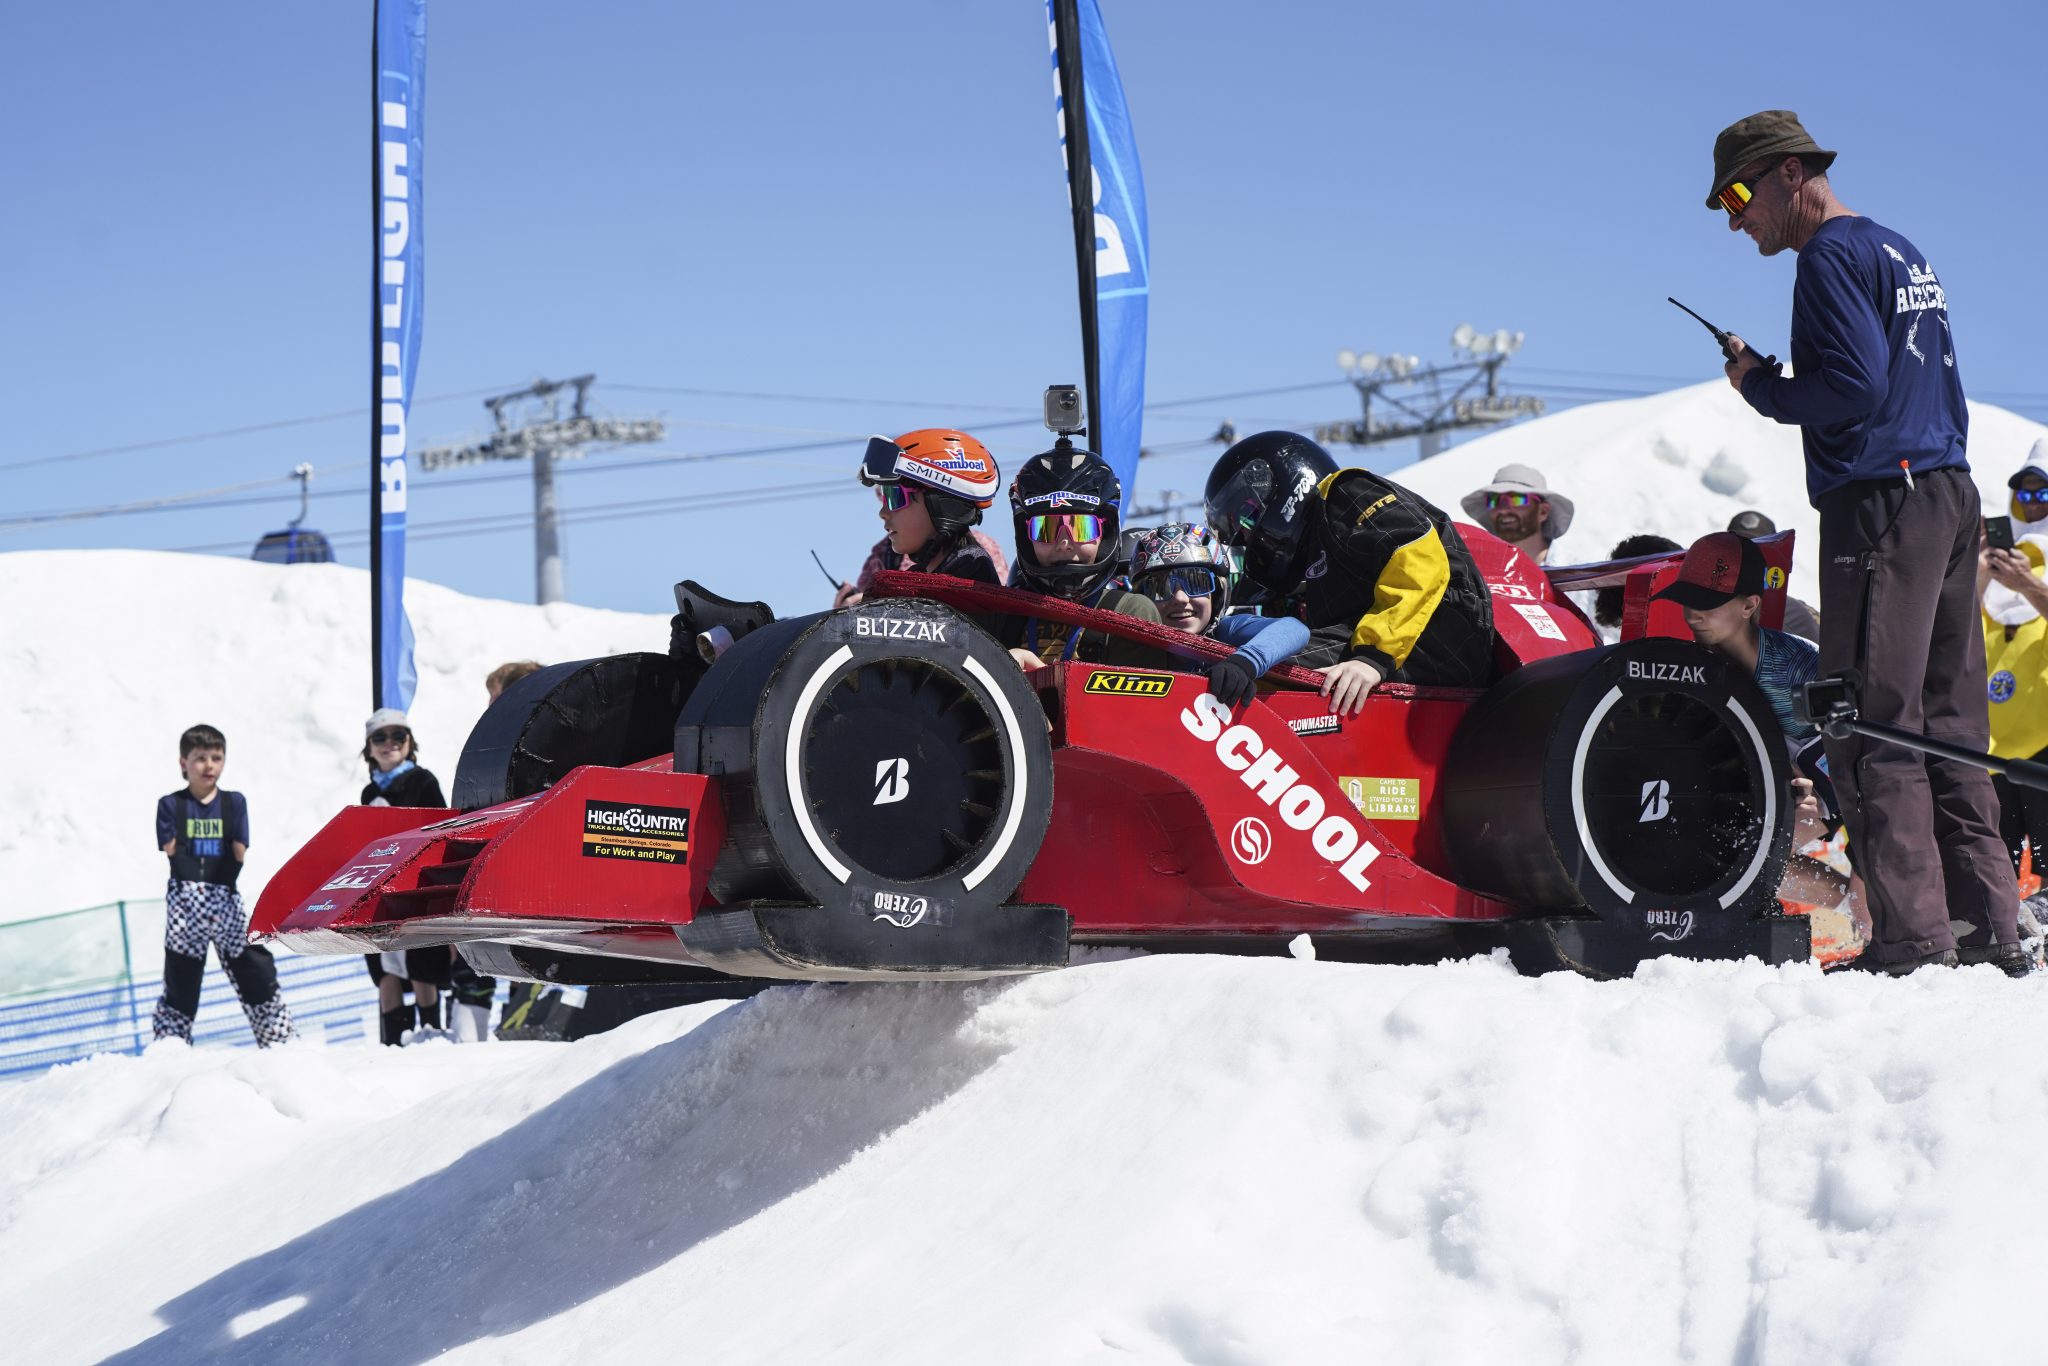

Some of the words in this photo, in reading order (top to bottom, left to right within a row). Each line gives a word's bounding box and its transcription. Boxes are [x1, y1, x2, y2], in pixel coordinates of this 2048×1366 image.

[906, 462, 952, 485] SMITH
[856, 617, 946, 642] BLIZZAK
[1629, 661, 1706, 683] BLIZZAK
[1090, 675, 1166, 693] Klim
[1181, 693, 1381, 893] SCHOOL
[1380, 786, 1406, 795] RIDE
[1369, 804, 1416, 813] LIBRARY
[194, 819, 219, 834] RUN
[195, 839, 220, 855] THE
[595, 845, 611, 855] For
[612, 847, 636, 857] Work
[638, 850, 655, 858] and
[656, 850, 676, 862] Play
[874, 892, 910, 913] ZERO
[1647, 910, 1678, 925] ZERO
